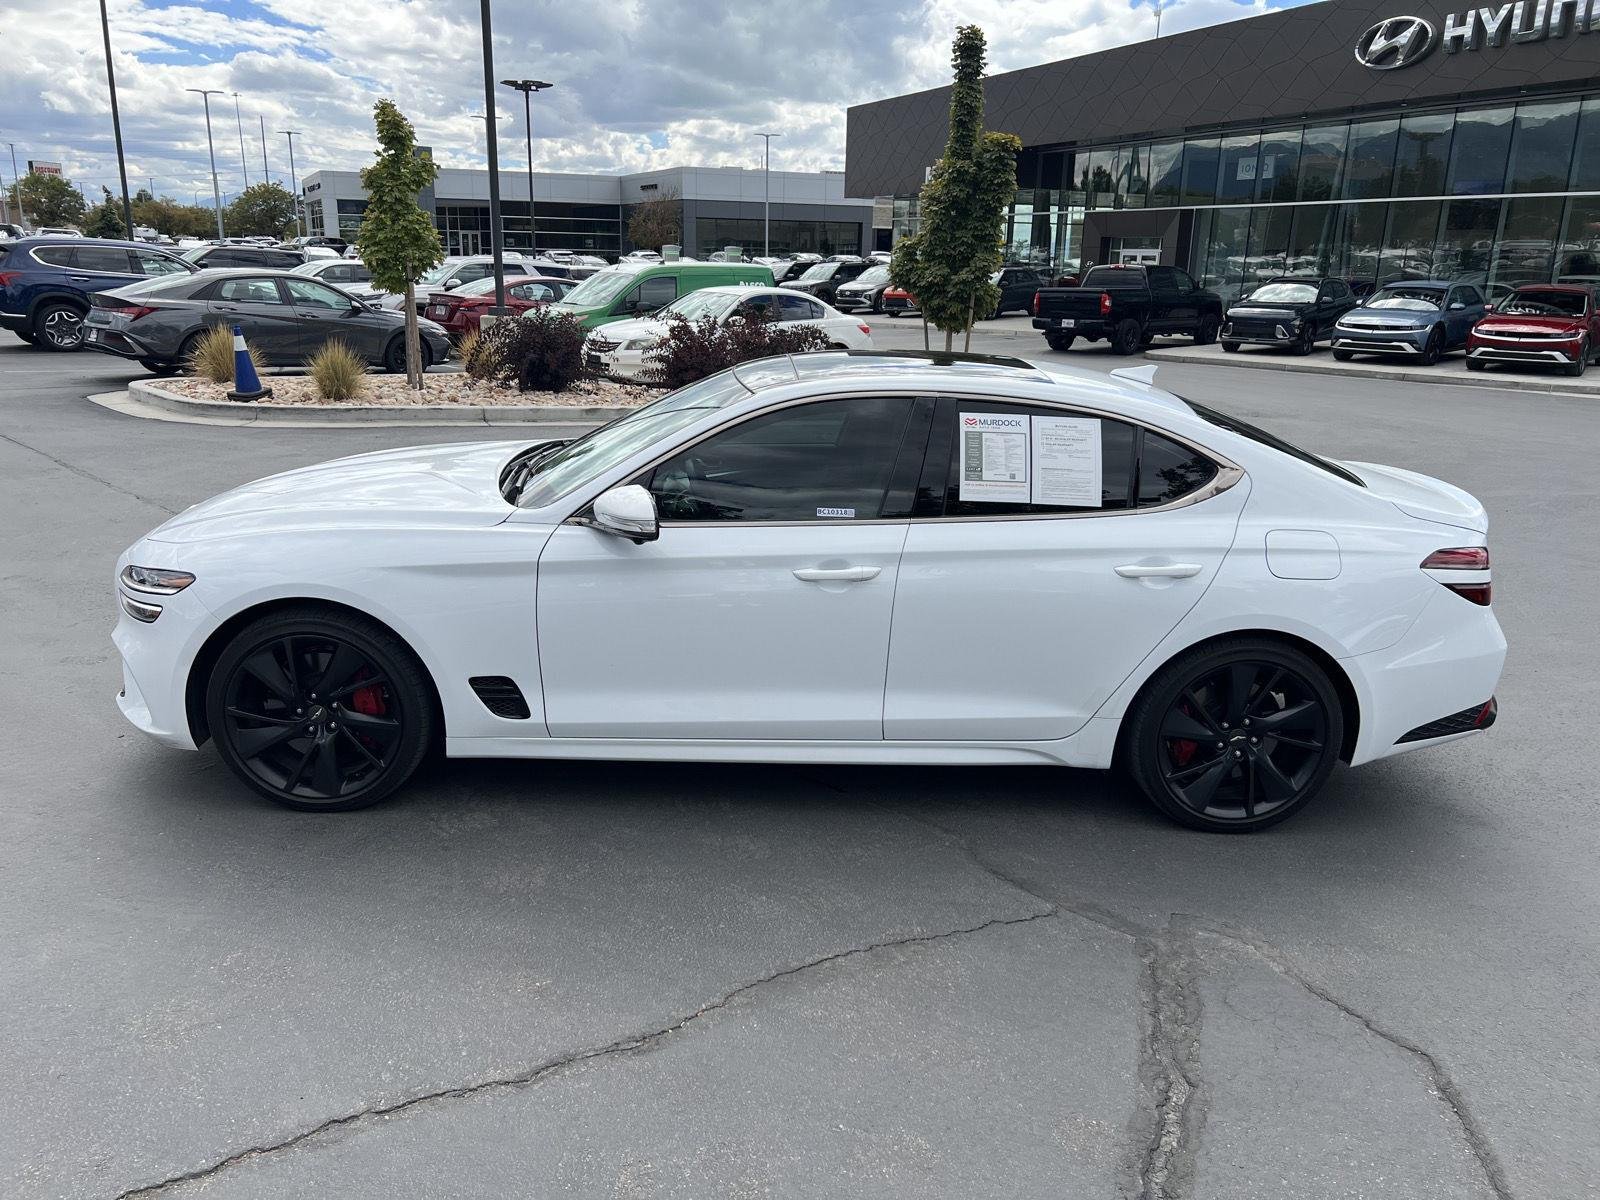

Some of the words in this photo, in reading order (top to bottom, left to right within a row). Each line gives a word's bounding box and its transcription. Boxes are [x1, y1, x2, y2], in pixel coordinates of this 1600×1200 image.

[1442, 0, 1600, 54] HYUN
[35, 166, 60, 174] DISCOUNT
[978, 418, 1022, 427] MURDOCK
